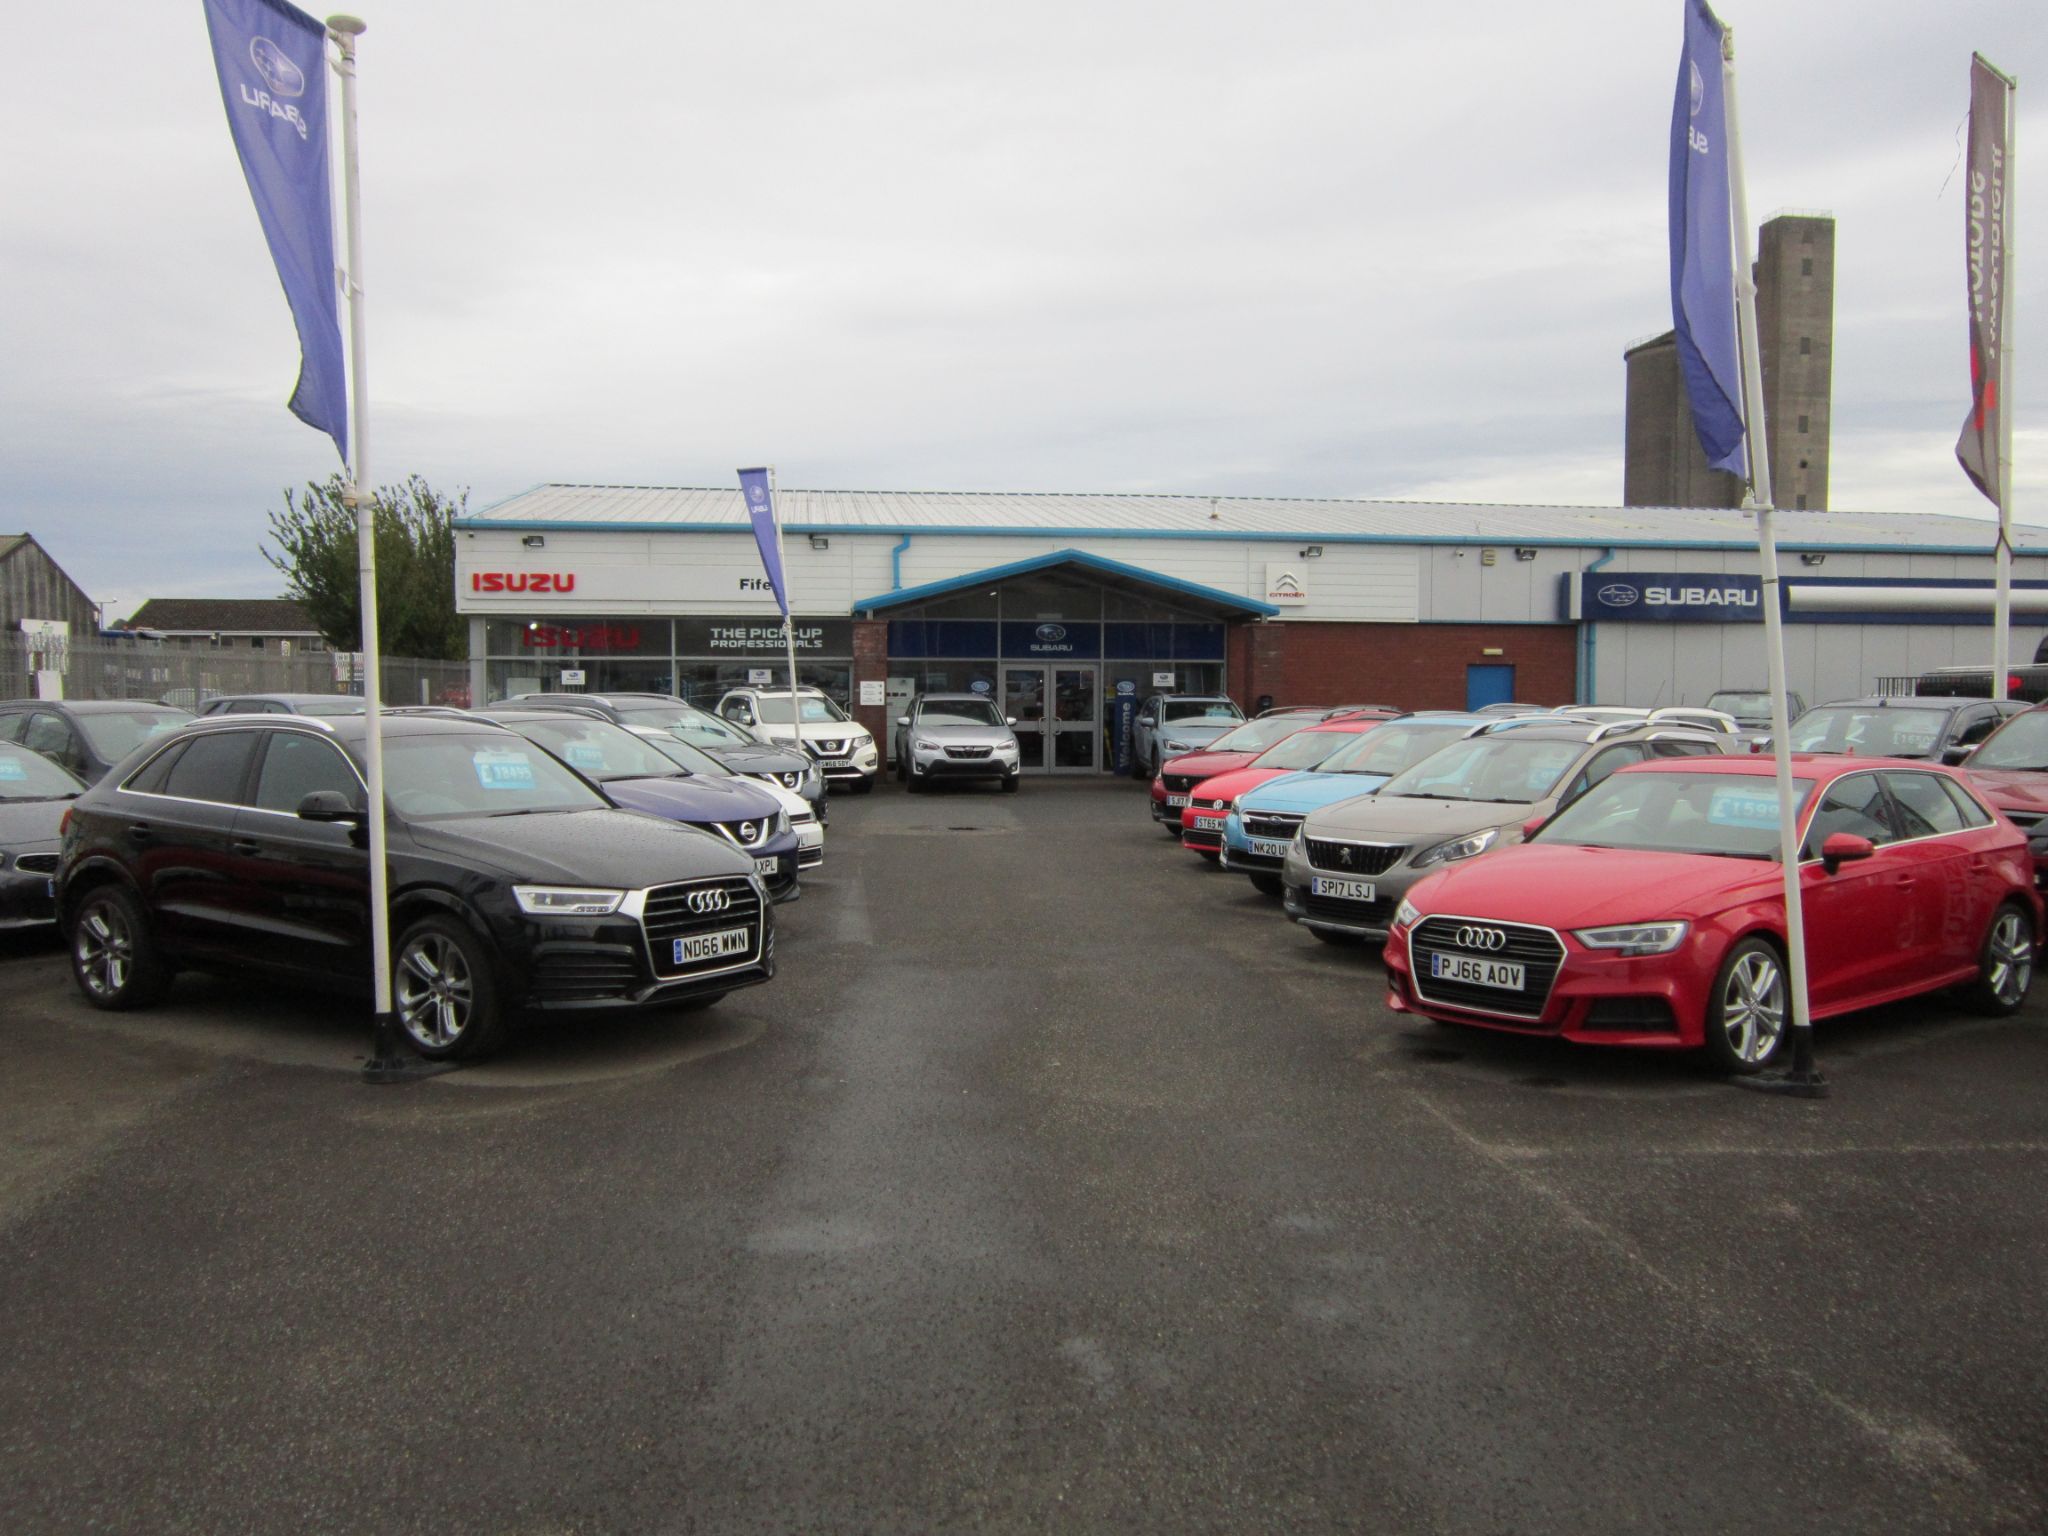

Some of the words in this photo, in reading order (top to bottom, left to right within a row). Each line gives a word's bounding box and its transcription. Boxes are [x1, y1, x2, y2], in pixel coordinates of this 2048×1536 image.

[472, 572, 575, 593] ISUZU
[740, 578, 772, 591] Fife
[1644, 587, 1758, 607] SUBARU
[710, 628, 746, 639] THE
[710, 640, 823, 648] PROFESSIOALS
[1030, 644, 1073, 652] SUBARU
[1119, 702, 1132, 768] Welcome
[1254, 842, 1277, 855] NK20
[1321, 880, 1346, 897] SP17
[1347, 883, 1371, 899] LSJ
[683, 937, 719, 960] ND66
[721, 931, 746, 950] WWN
[1442, 958, 1482, 981] PJ66
[1487, 965, 1521, 986] AOV
